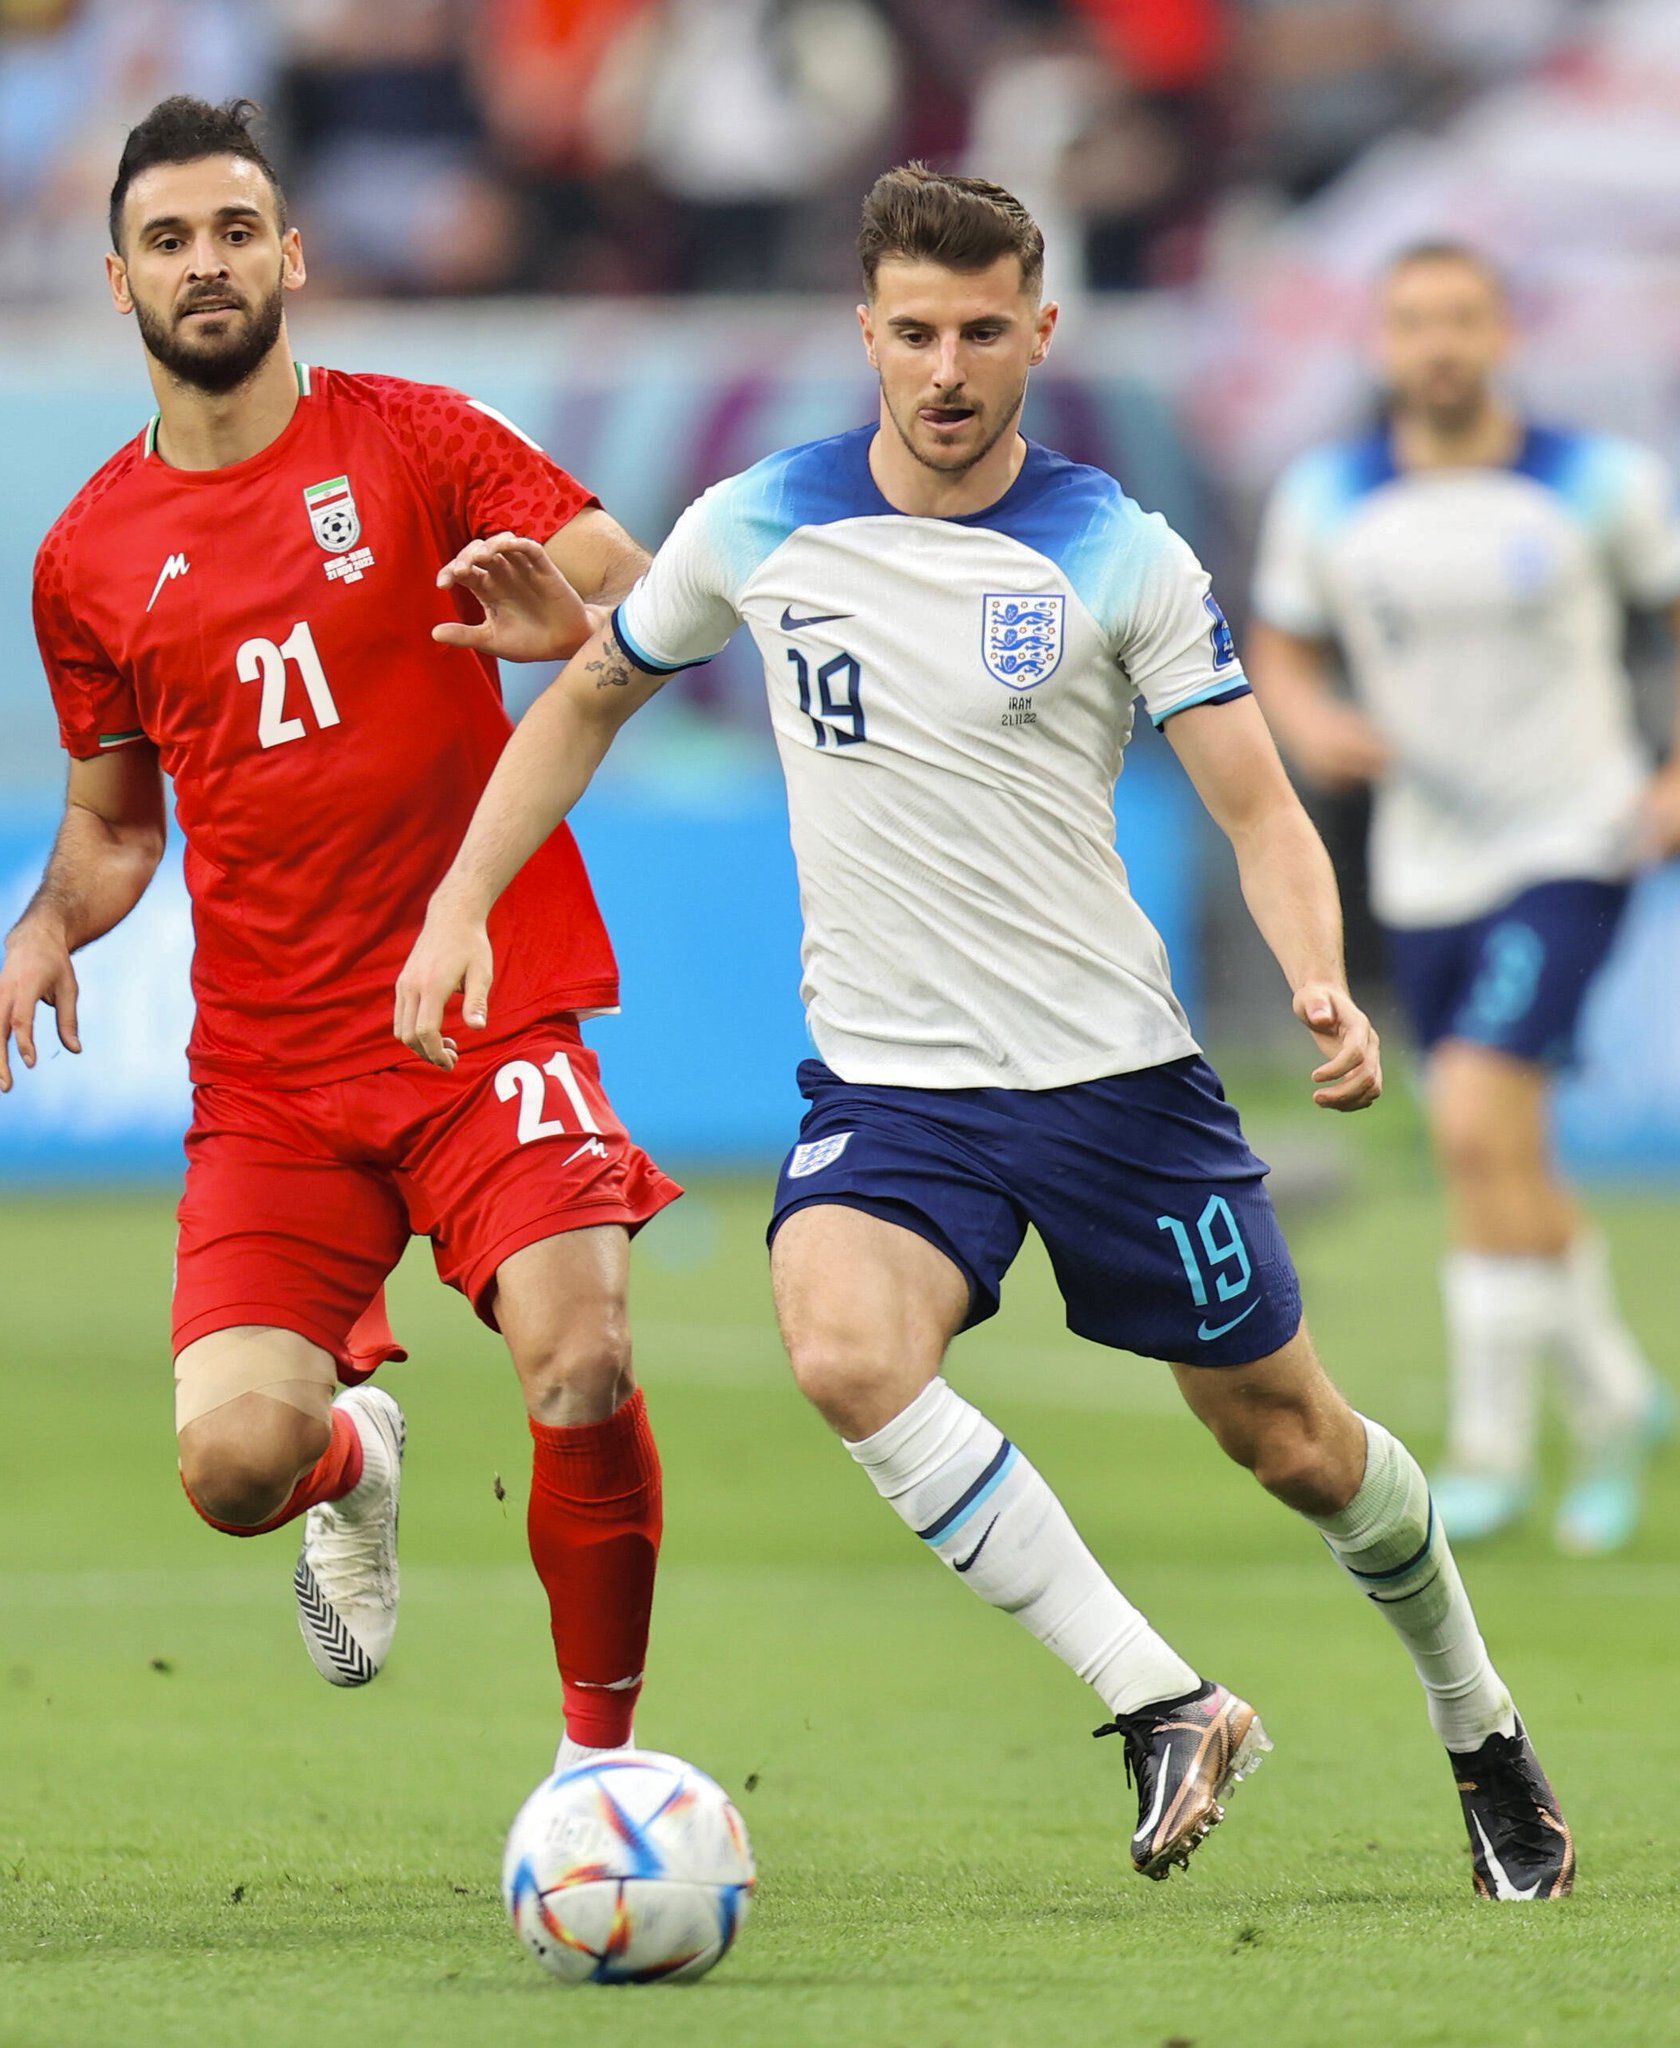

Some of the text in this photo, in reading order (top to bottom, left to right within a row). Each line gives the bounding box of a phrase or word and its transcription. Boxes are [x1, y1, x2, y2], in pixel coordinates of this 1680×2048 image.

[235, 620, 342, 749] 21
[787, 648, 867, 747] 19
[494, 1051, 603, 1145] 21
[1156, 1193, 1252, 1307] 19
